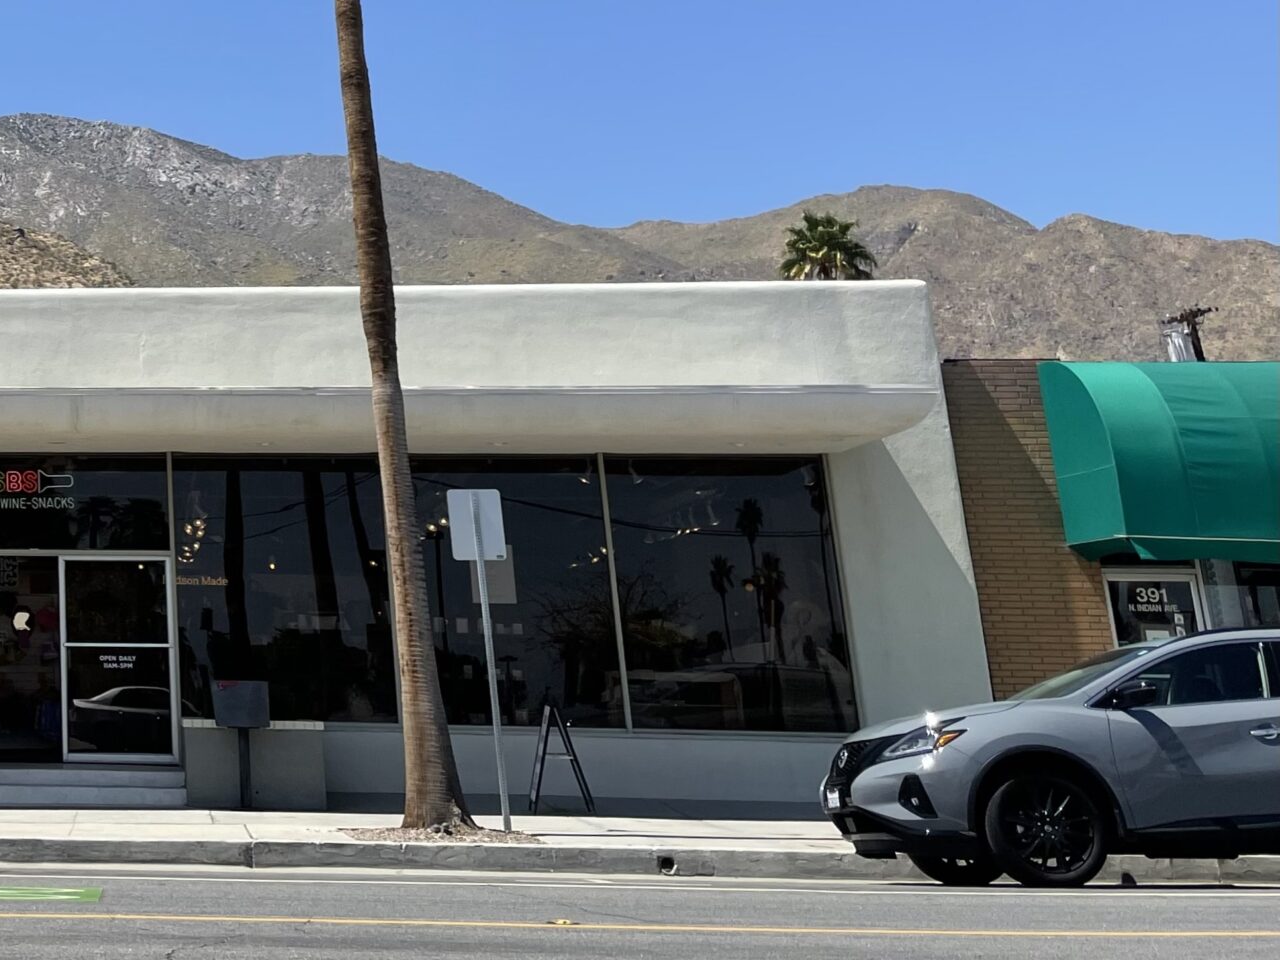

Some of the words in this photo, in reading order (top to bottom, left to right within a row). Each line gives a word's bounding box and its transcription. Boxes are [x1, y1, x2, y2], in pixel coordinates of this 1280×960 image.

[201, 576, 229, 586] Made
[1135, 587, 1168, 603] 391
[1136, 603, 1162, 613] INDIAN
